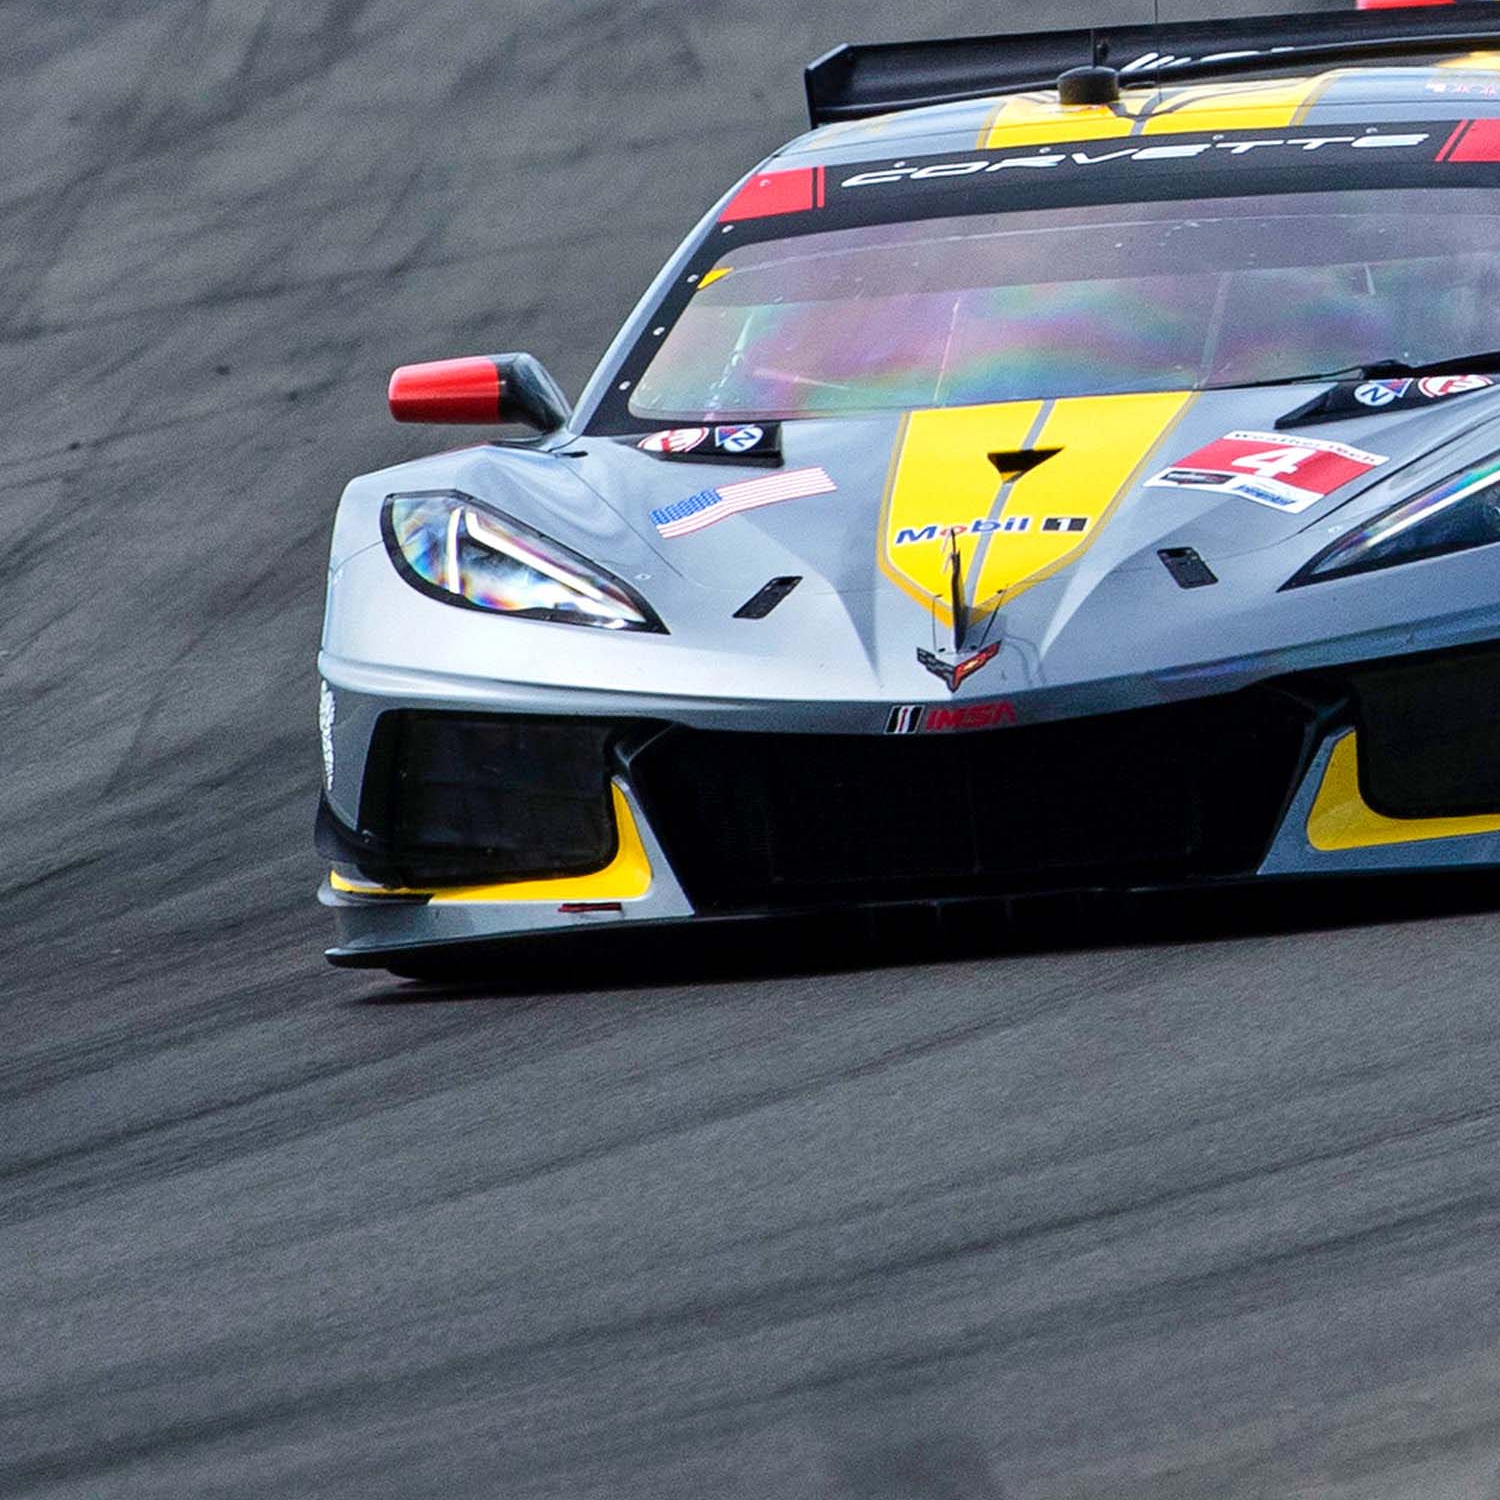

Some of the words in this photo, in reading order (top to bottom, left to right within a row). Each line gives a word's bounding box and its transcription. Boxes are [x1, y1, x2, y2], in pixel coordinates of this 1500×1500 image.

[841, 132, 1430, 188] CORVETTE
[1231, 447, 1318, 479] 4
[895, 517, 1030, 544] Mobil
[926, 702, 1018, 731] IMSA
